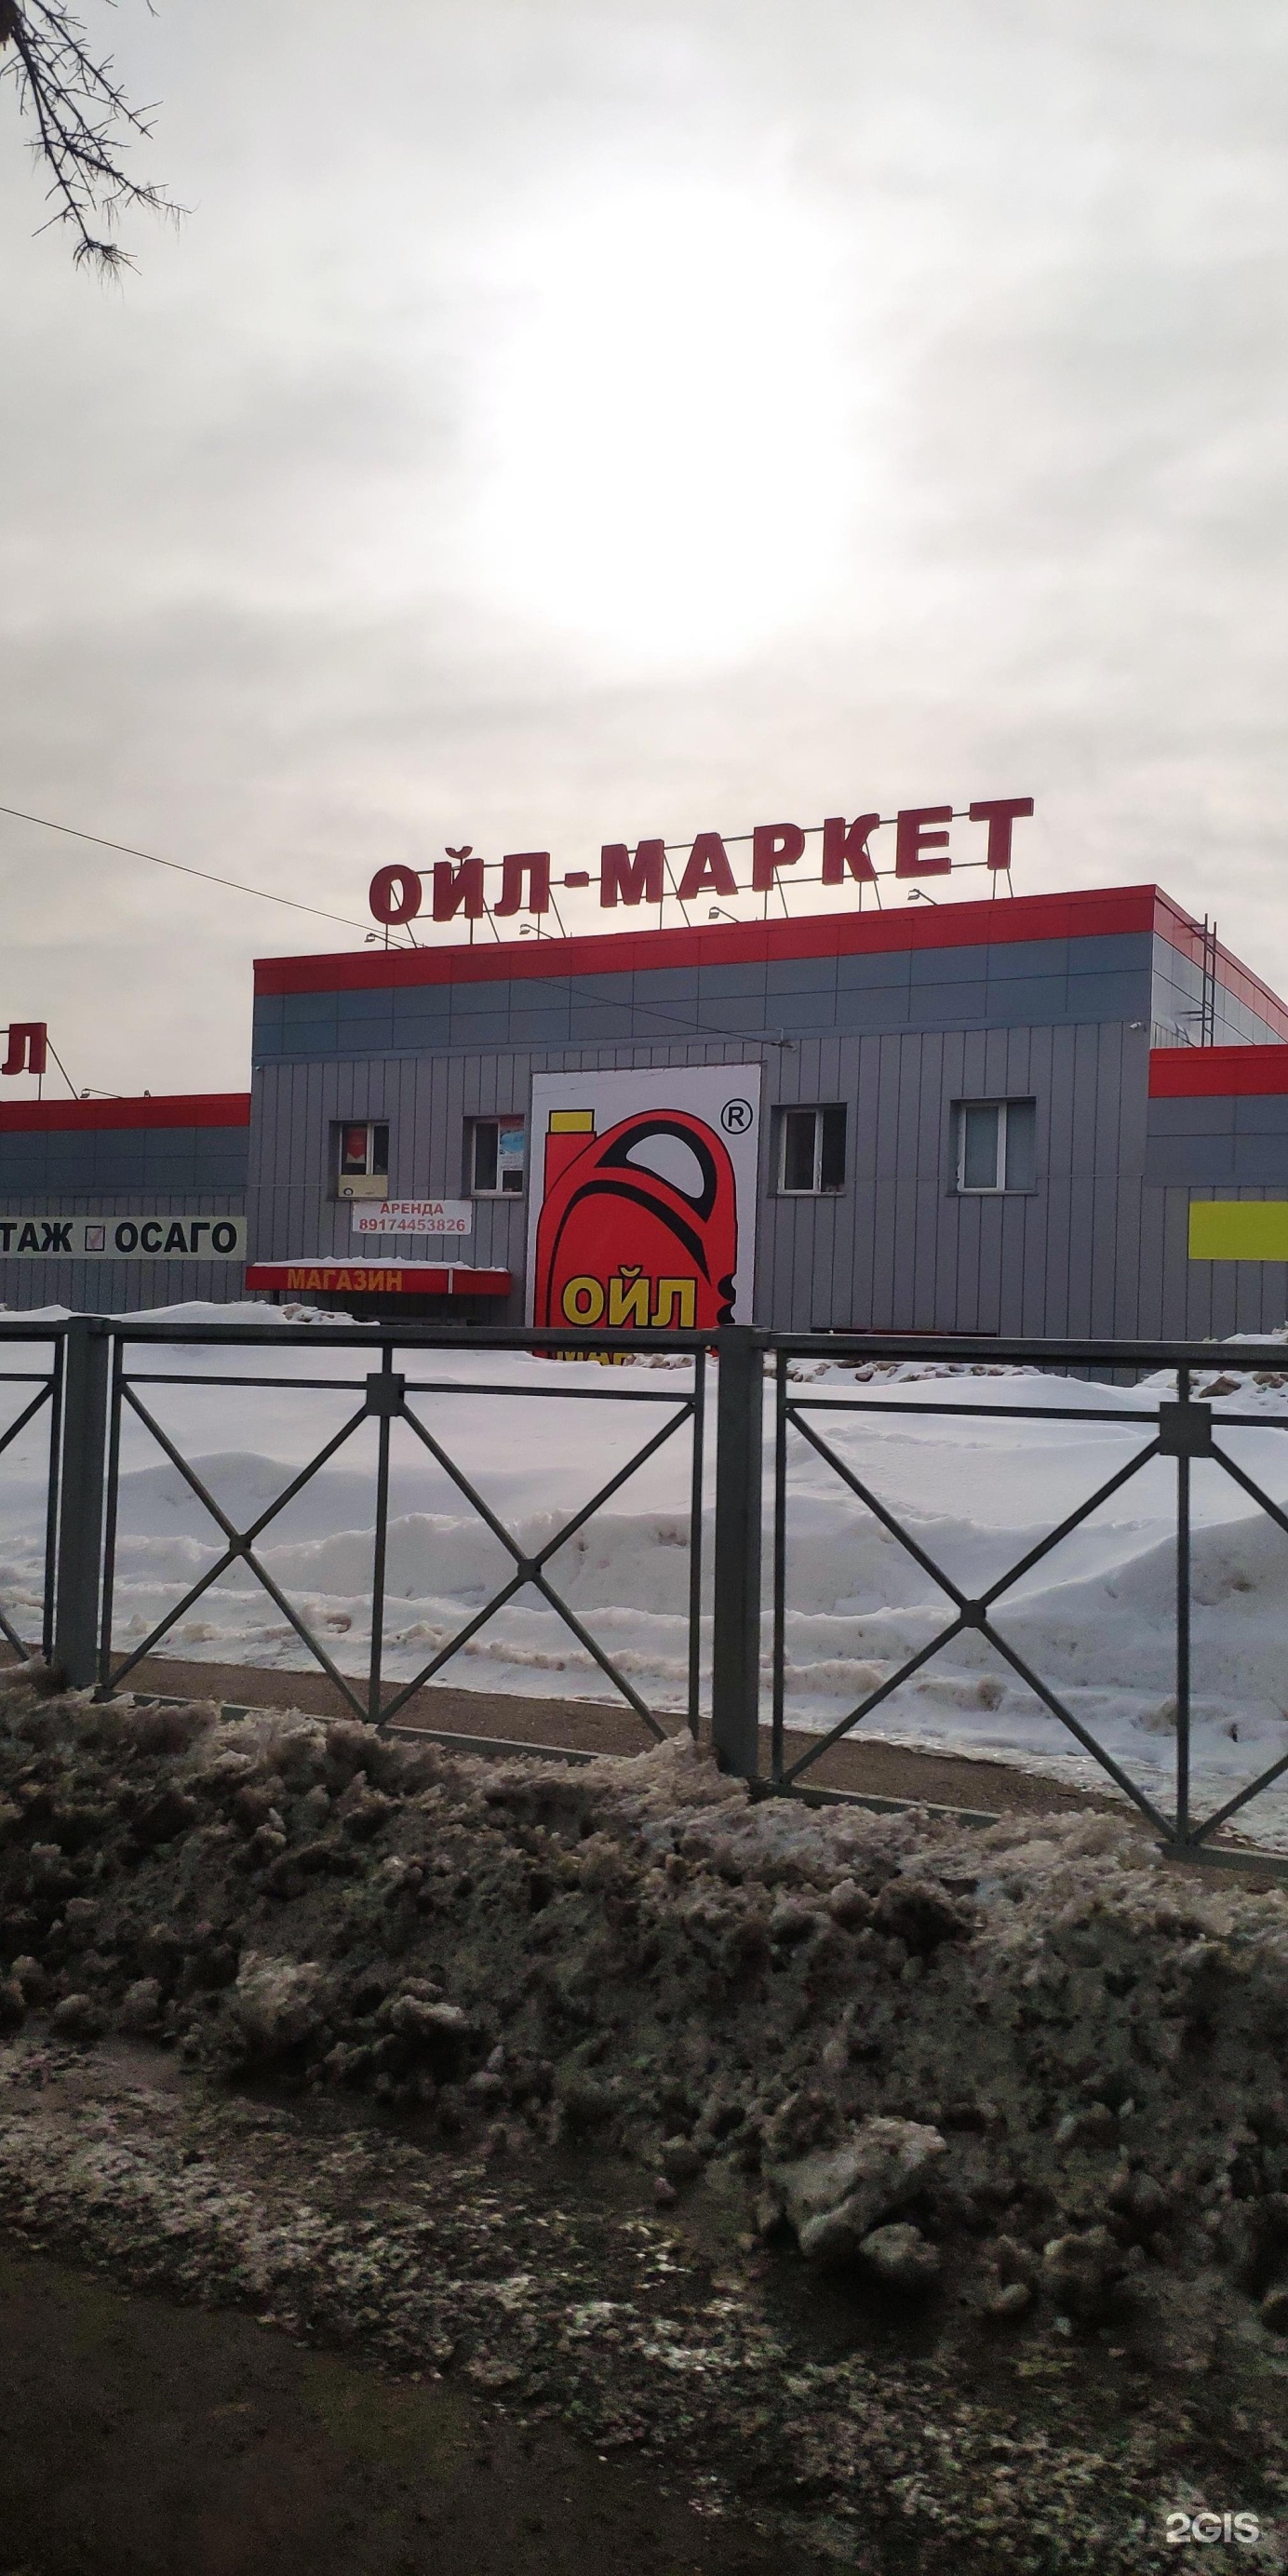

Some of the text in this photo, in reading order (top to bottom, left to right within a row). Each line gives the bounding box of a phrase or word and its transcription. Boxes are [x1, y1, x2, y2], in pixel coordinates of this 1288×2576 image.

[369, 797, 1034, 925] ОЙЛ-МАРКЕТ
[381, 1203, 444, 1215] АРЕНДА
[0, 1221, 237, 1254] ТАЖ ОСАГО
[359, 1218, 465, 1231] 89174453826
[287, 1268, 403, 1292] МАГАЗИН
[562, 1266, 696, 1328] ОЙЛ
